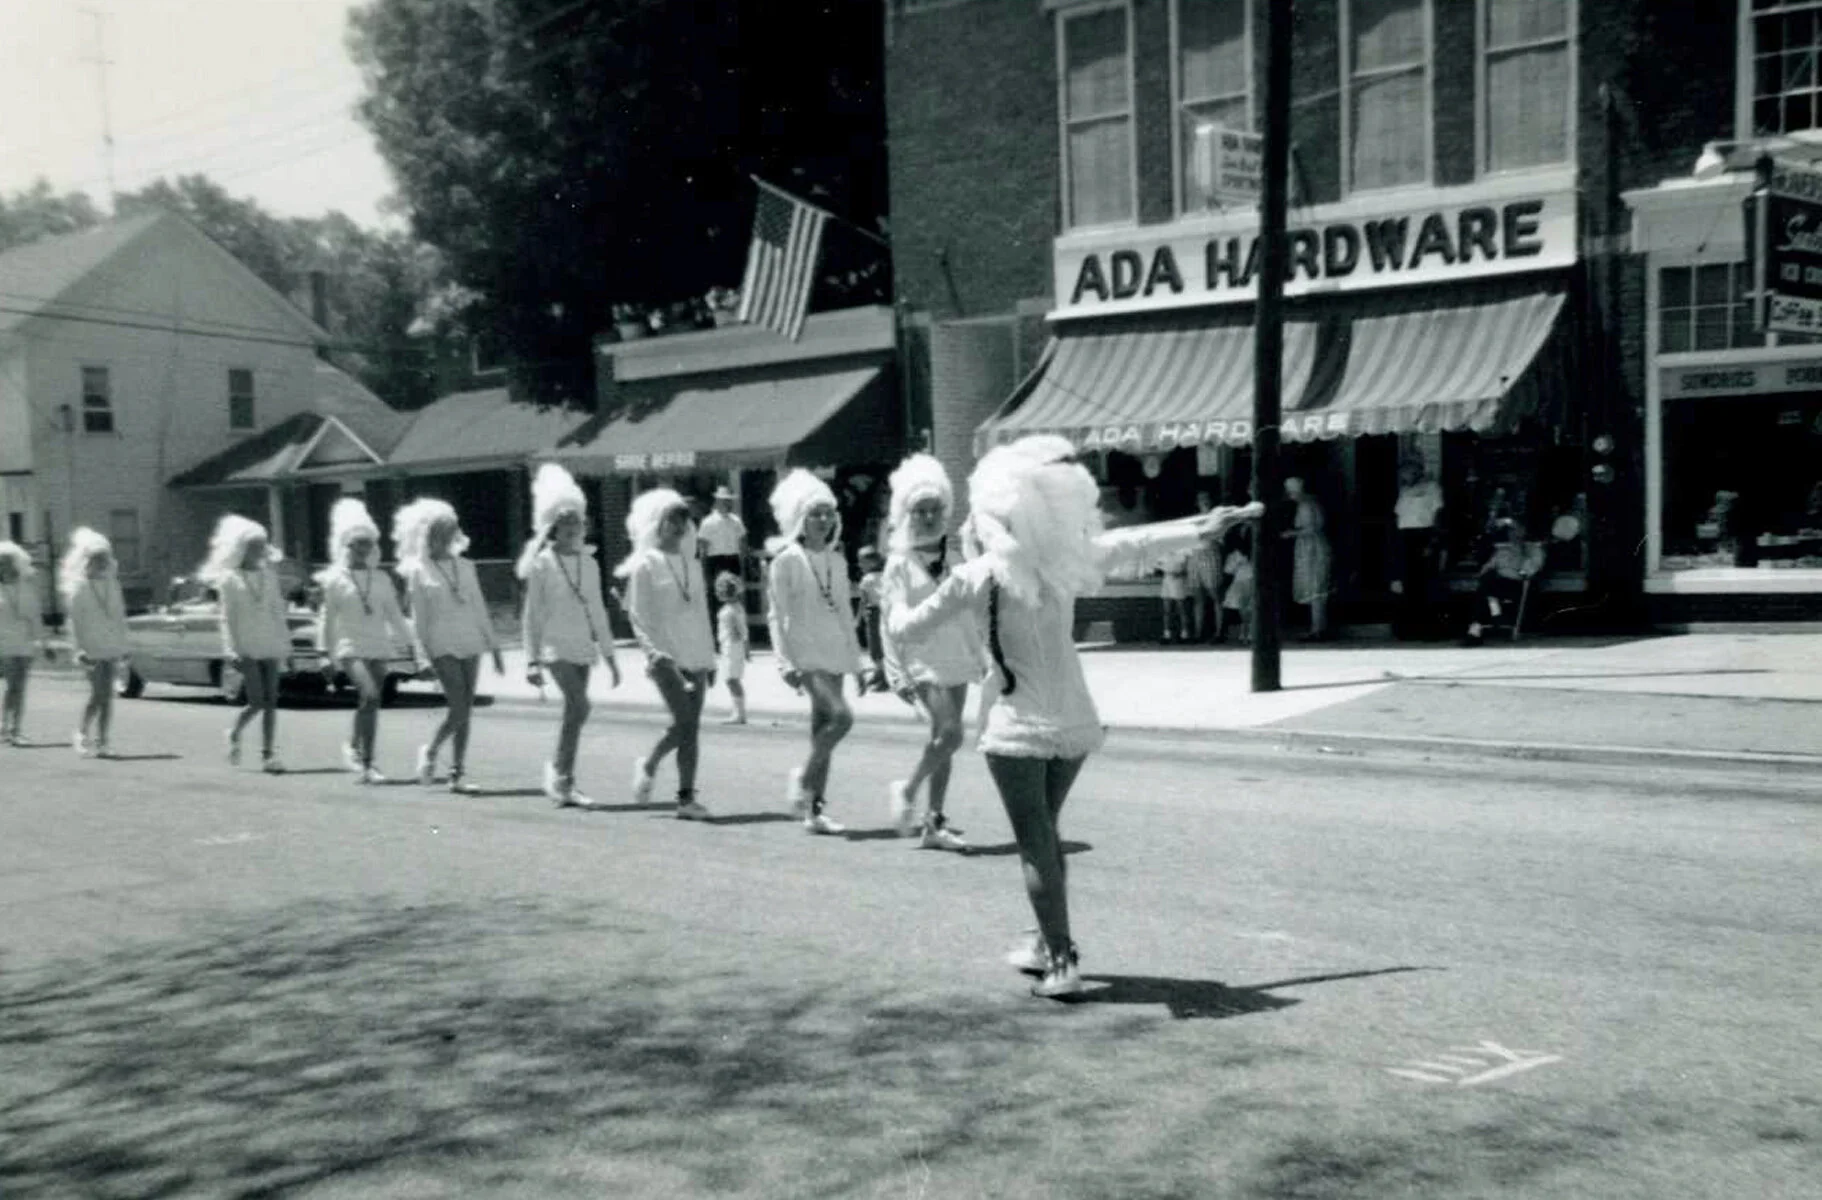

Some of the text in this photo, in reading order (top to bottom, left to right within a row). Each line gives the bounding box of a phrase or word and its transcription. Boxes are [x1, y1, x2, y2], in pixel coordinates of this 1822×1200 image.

[1072, 245, 1184, 303] ADA
[1084, 413, 1348, 446] ADA HARDARE
